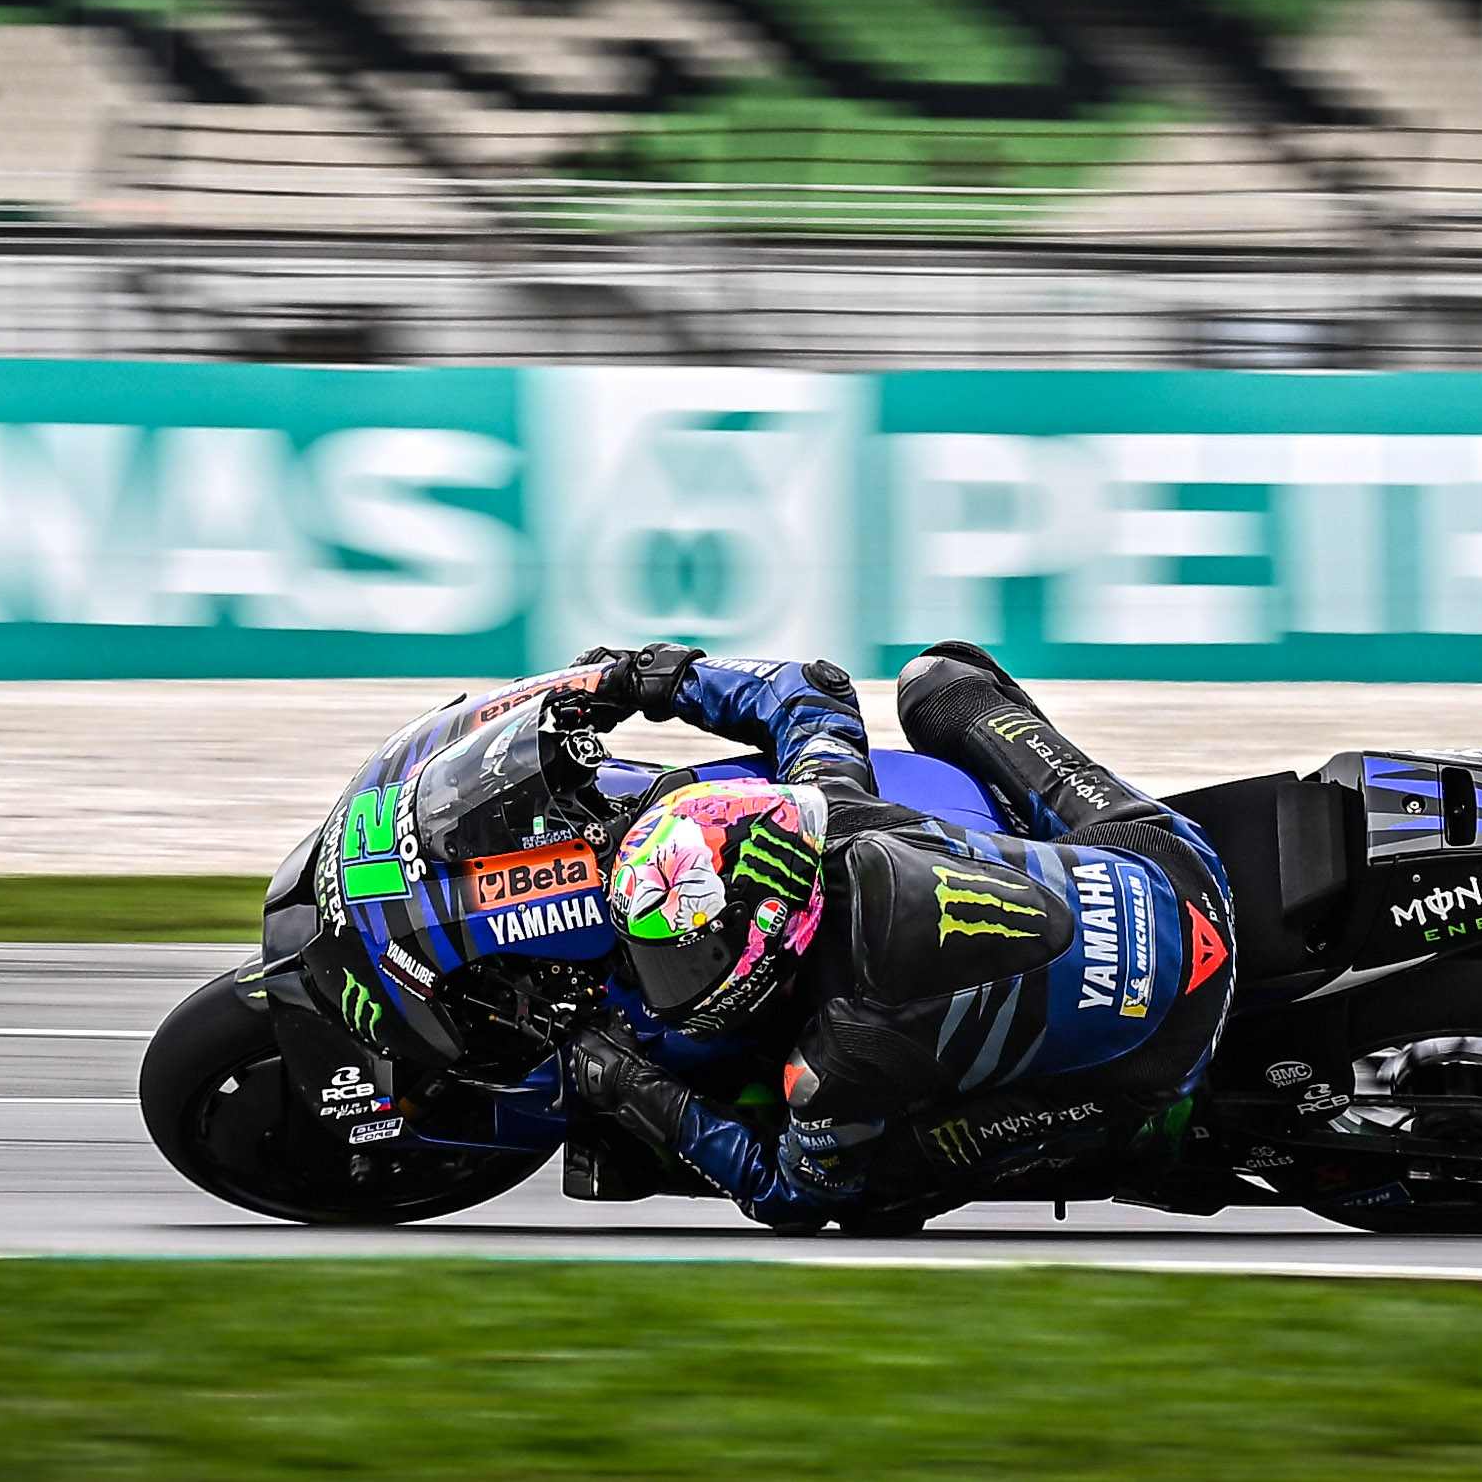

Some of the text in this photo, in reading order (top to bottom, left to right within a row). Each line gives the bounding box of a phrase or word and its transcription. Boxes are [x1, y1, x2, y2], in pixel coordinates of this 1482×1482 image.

[1026, 734, 1111, 810] MONSTER
[342, 780, 414, 905] 21
[396, 774, 427, 882] ENEOS
[324, 805, 348, 937] MONSTER
[508, 858, 588, 896] Beta
[486, 895, 604, 946] YAMAHA
[1071, 862, 1119, 1010] YAMAHA
[1127, 875, 1149, 973] MICHELIN
[385, 939, 436, 989] YAMALUBE
[321, 1083, 375, 1103] RCB
[1270, 1064, 1308, 1083] BMC
[1296, 1094, 1351, 1115] RCB
[1245, 1155, 1295, 1169] GILLES
